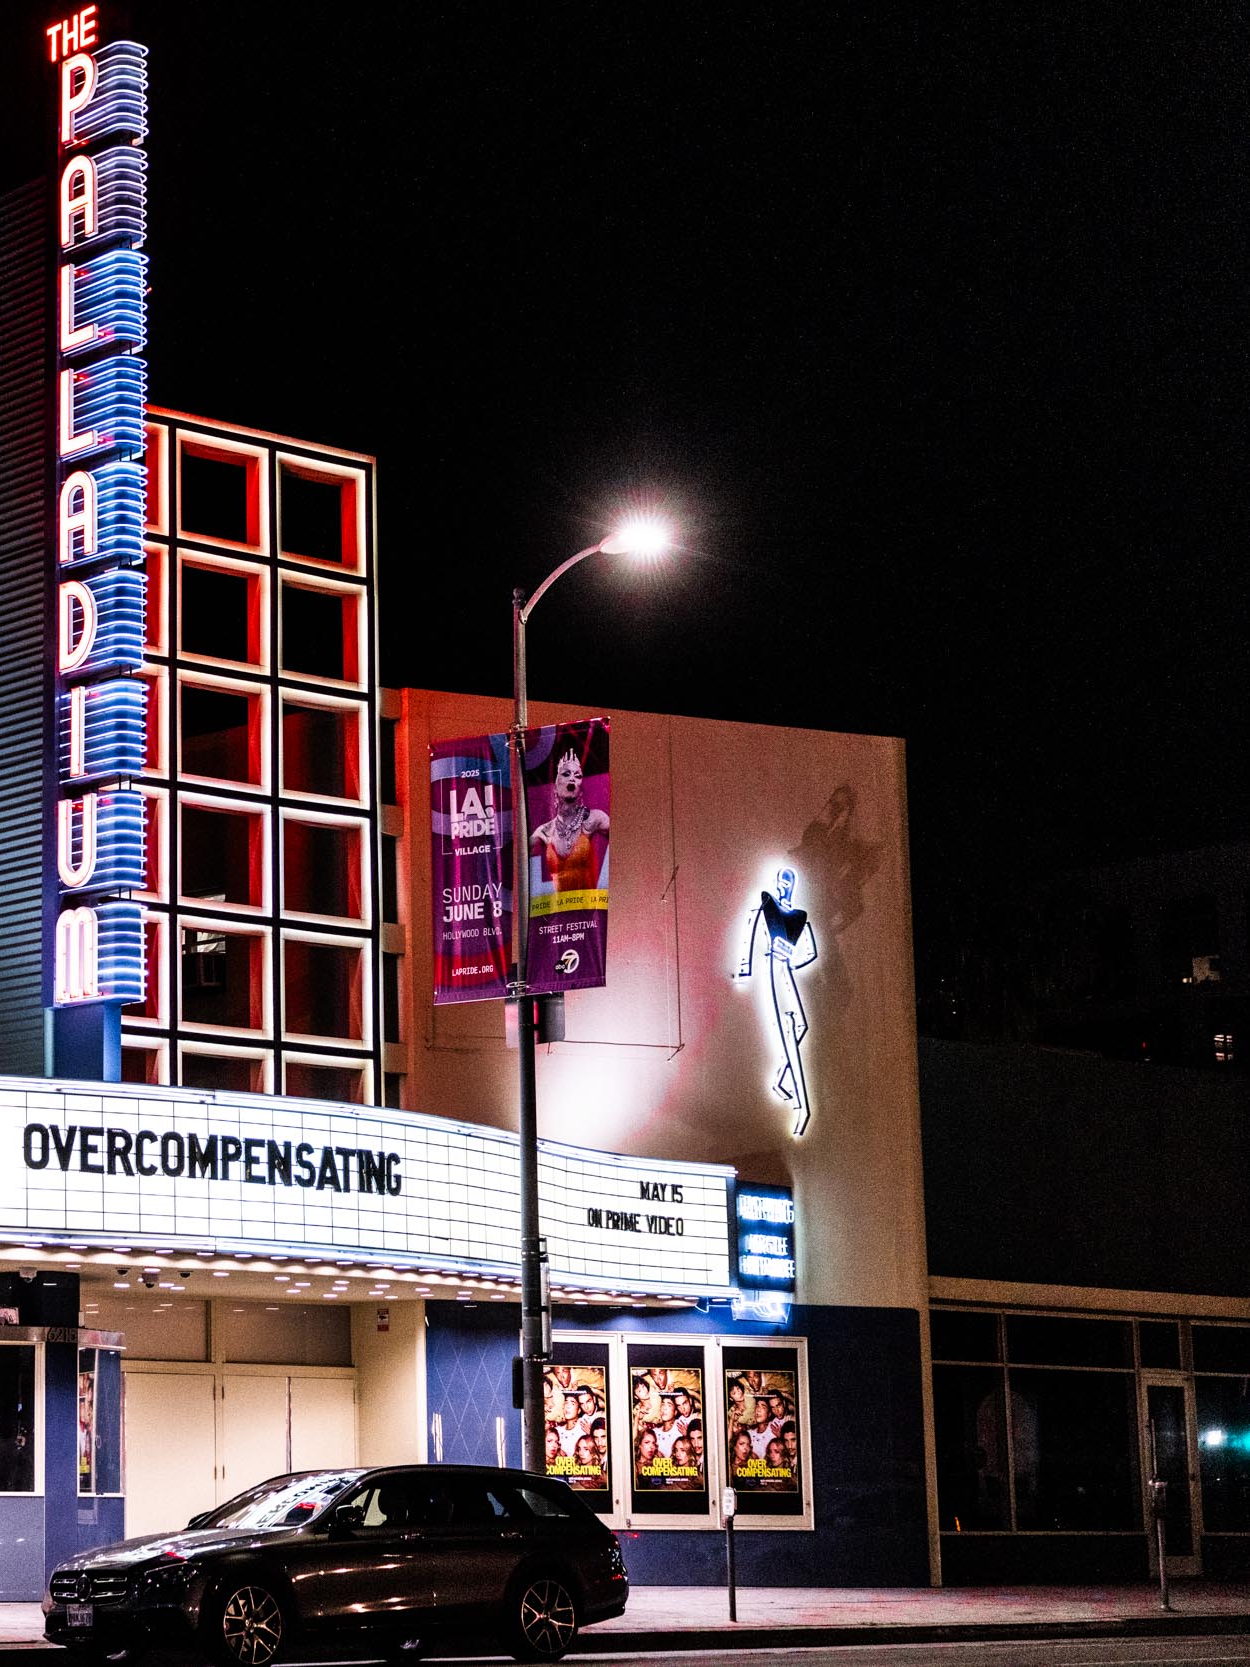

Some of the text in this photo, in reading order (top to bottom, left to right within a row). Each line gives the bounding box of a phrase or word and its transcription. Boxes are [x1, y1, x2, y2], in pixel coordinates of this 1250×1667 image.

[47, 5, 96, 62] THE
[56, 52, 99, 1003] PALLADIUM
[461, 769, 480, 778] 2025
[450, 784, 495, 823] LA!
[451, 818, 496, 839] PRIDE
[455, 844, 491, 856] VILLAGE
[442, 882, 502, 904] SUNDAY
[443, 901, 502, 922] JUNE 8
[443, 928, 480, 940] HOLLYWOOD
[538, 920, 598, 935] STREET FESTIVAL
[452, 964, 494, 976] LAPRIDE.ORG
[23, 1123, 402, 1197] OVERCOMPENSATING
[640, 1181, 683, 1204] MAY 15
[587, 1208, 684, 1237] ON PRIME VIDEO
[555, 1456, 575, 1467] OVER
[653, 1457, 672, 1468] OVER
[747, 1459, 767, 1468] OVER
[642, 1466, 698, 1477] COMPENSATING
[736, 1467, 792, 1478] COMPENSATING
